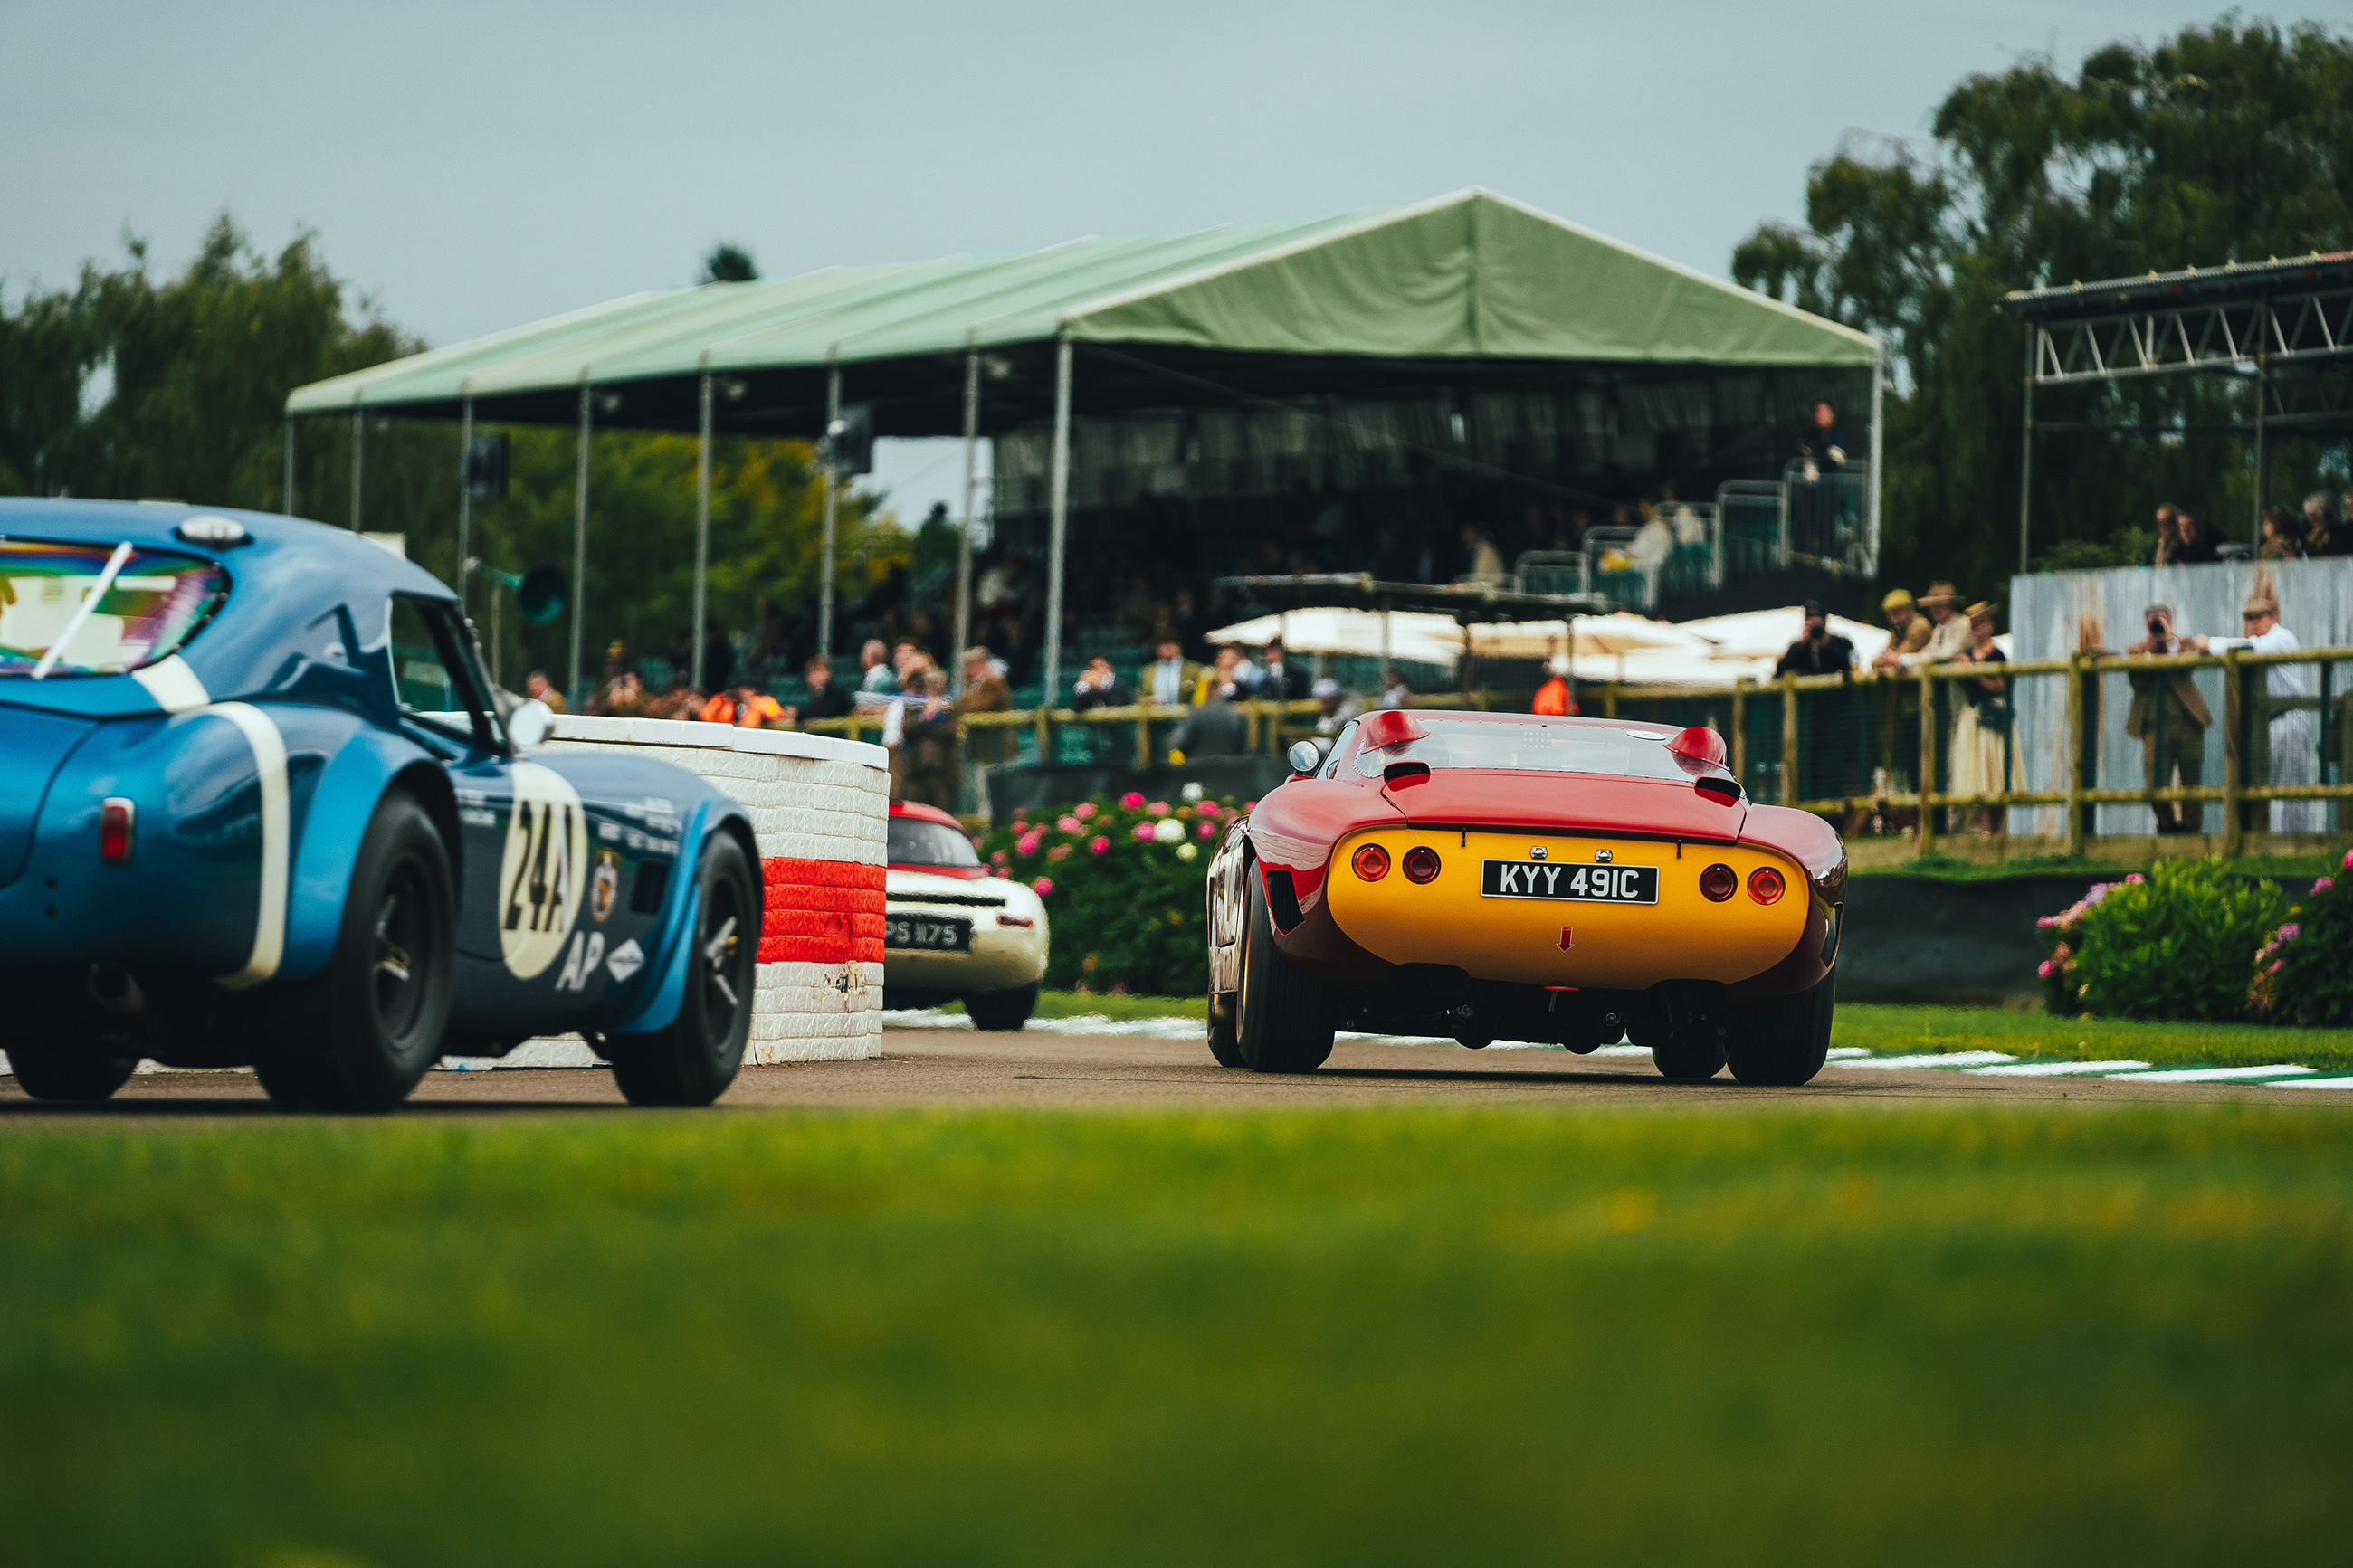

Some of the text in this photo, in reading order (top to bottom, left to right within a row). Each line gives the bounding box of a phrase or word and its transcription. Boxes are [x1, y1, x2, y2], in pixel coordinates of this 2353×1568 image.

[504, 800, 572, 932] 24A
[1500, 864, 1639, 898] KYY 491C
[555, 930, 605, 992] AP
